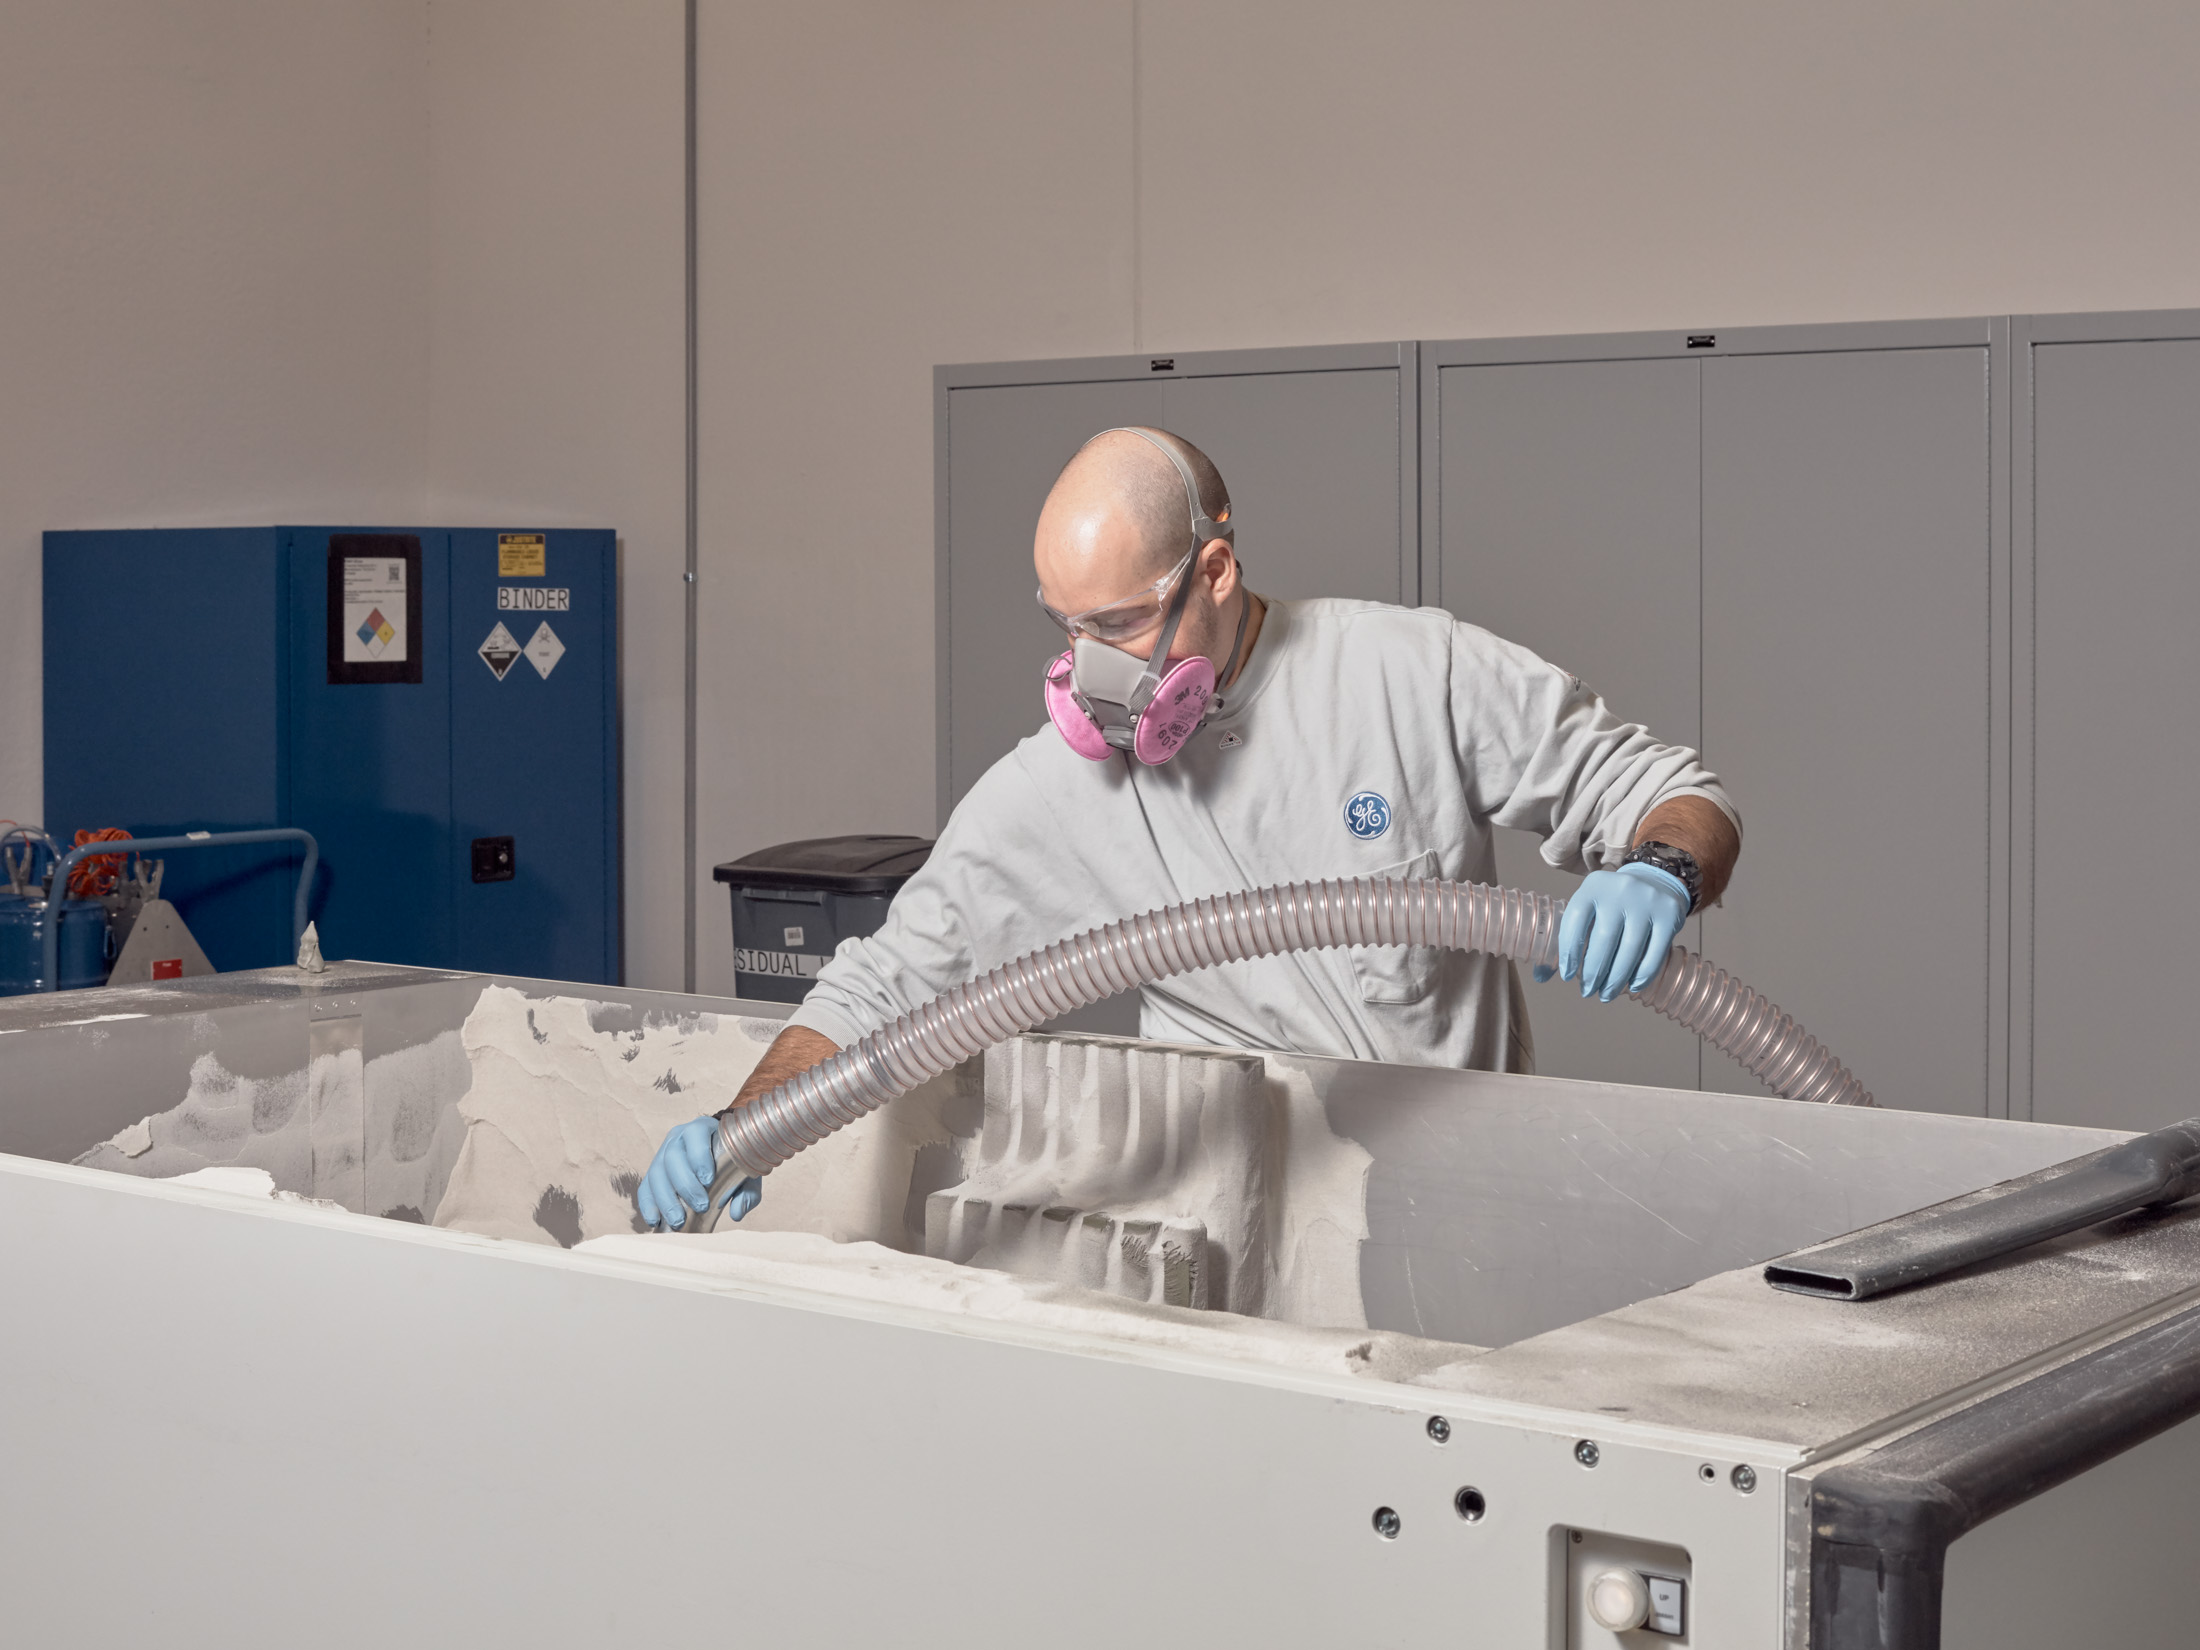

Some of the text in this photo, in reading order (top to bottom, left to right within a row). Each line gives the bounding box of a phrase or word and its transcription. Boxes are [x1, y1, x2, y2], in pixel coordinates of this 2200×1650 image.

[499, 588, 568, 609] BINDER
[1174, 686, 1190, 706] 3M
[1170, 723, 1189, 734] P100
[1659, 1593, 1670, 1601] UP
